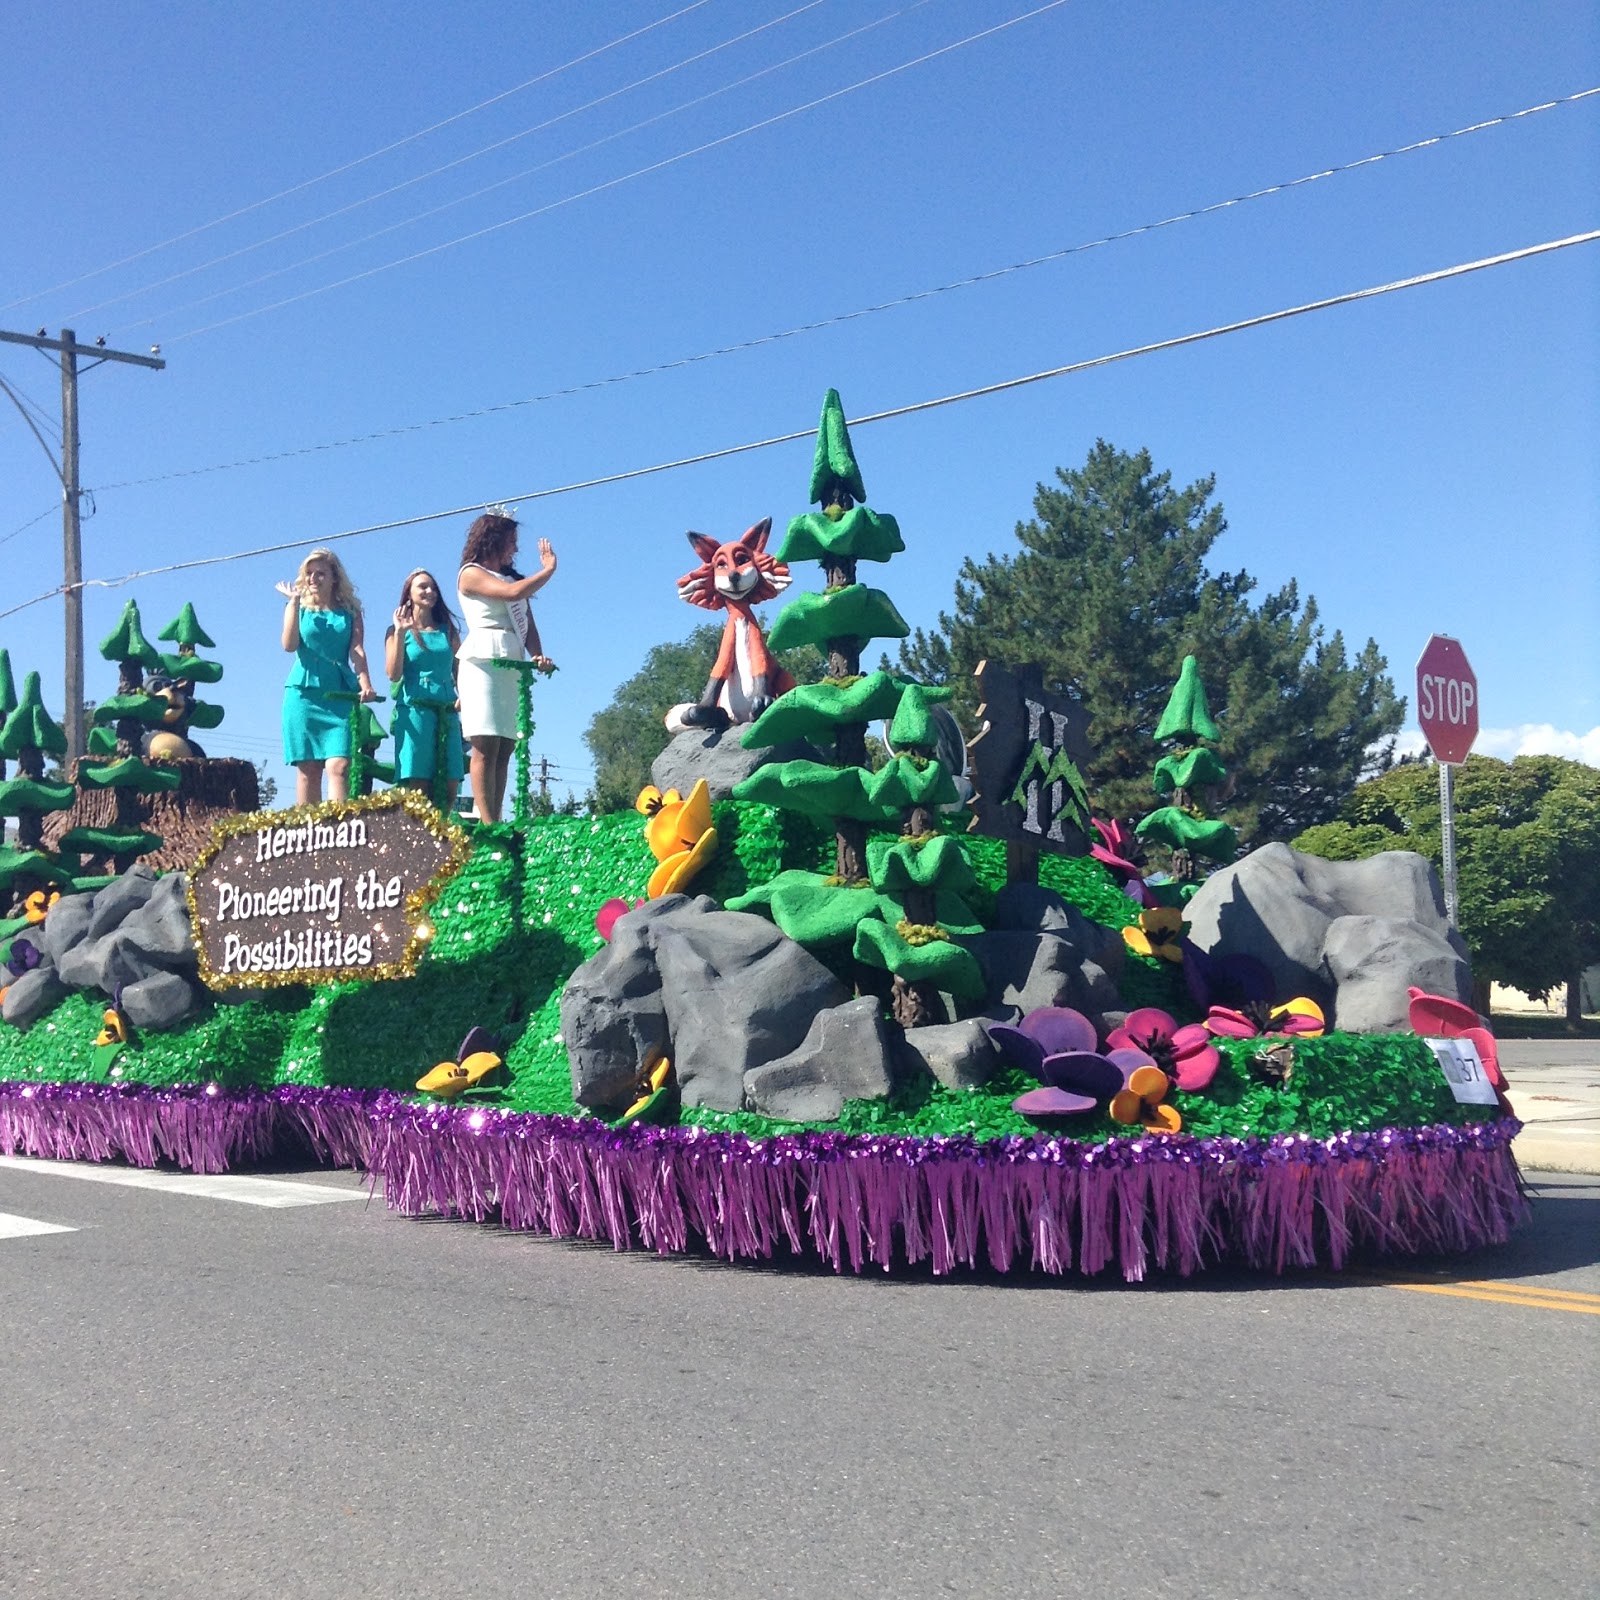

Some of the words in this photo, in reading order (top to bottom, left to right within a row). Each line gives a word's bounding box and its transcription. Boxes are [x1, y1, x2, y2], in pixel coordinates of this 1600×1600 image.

[1422, 673, 1474, 725] STOP
[255, 818, 366, 862] Herriman
[217, 877, 342, 921] Pioneering
[355, 868, 401, 911] the
[222, 929, 372, 973] Possibilities
[1456, 1057, 1479, 1082] 37
